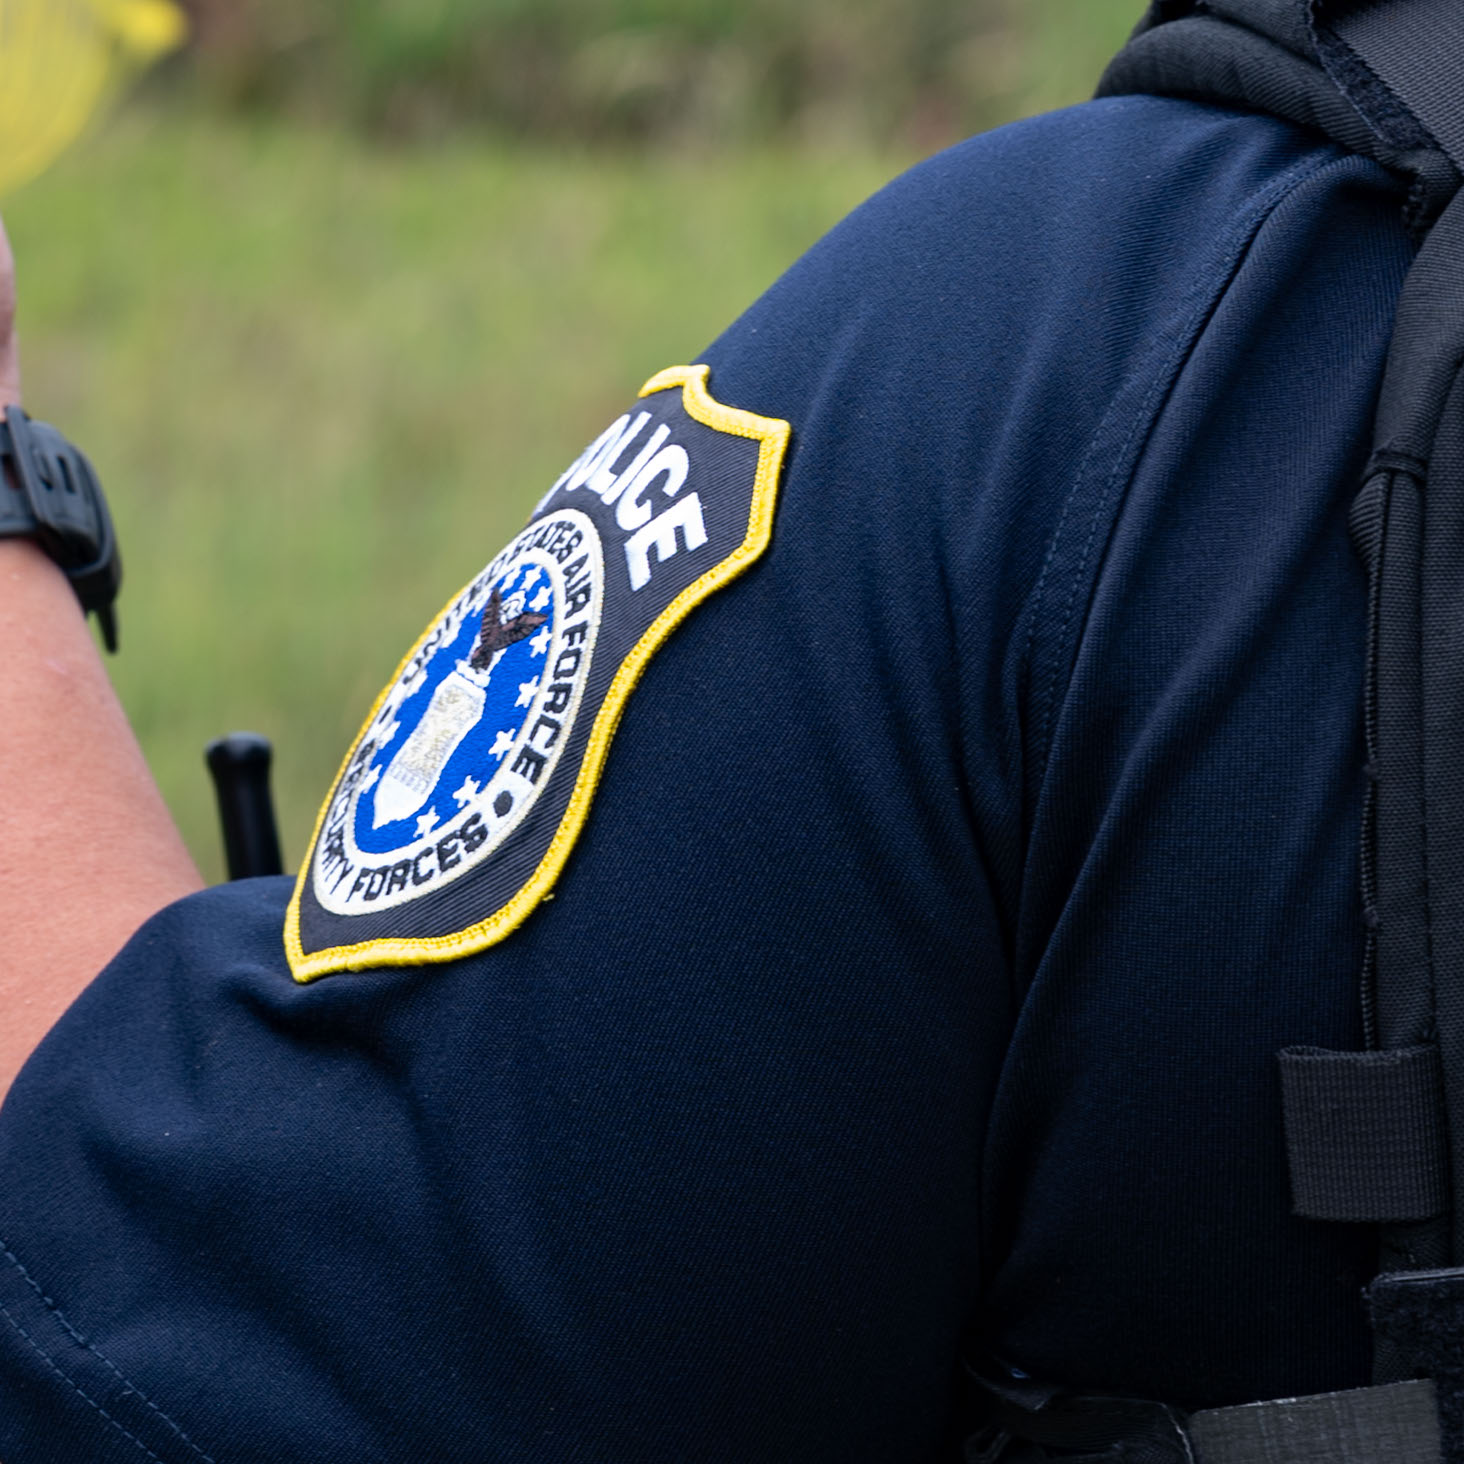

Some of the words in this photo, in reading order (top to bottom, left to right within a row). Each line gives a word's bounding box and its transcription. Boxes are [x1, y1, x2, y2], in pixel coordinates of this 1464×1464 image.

[561, 552, 592, 620] AIR
[510, 620, 589, 786] FORCE
[345, 812, 489, 903] FORCES
